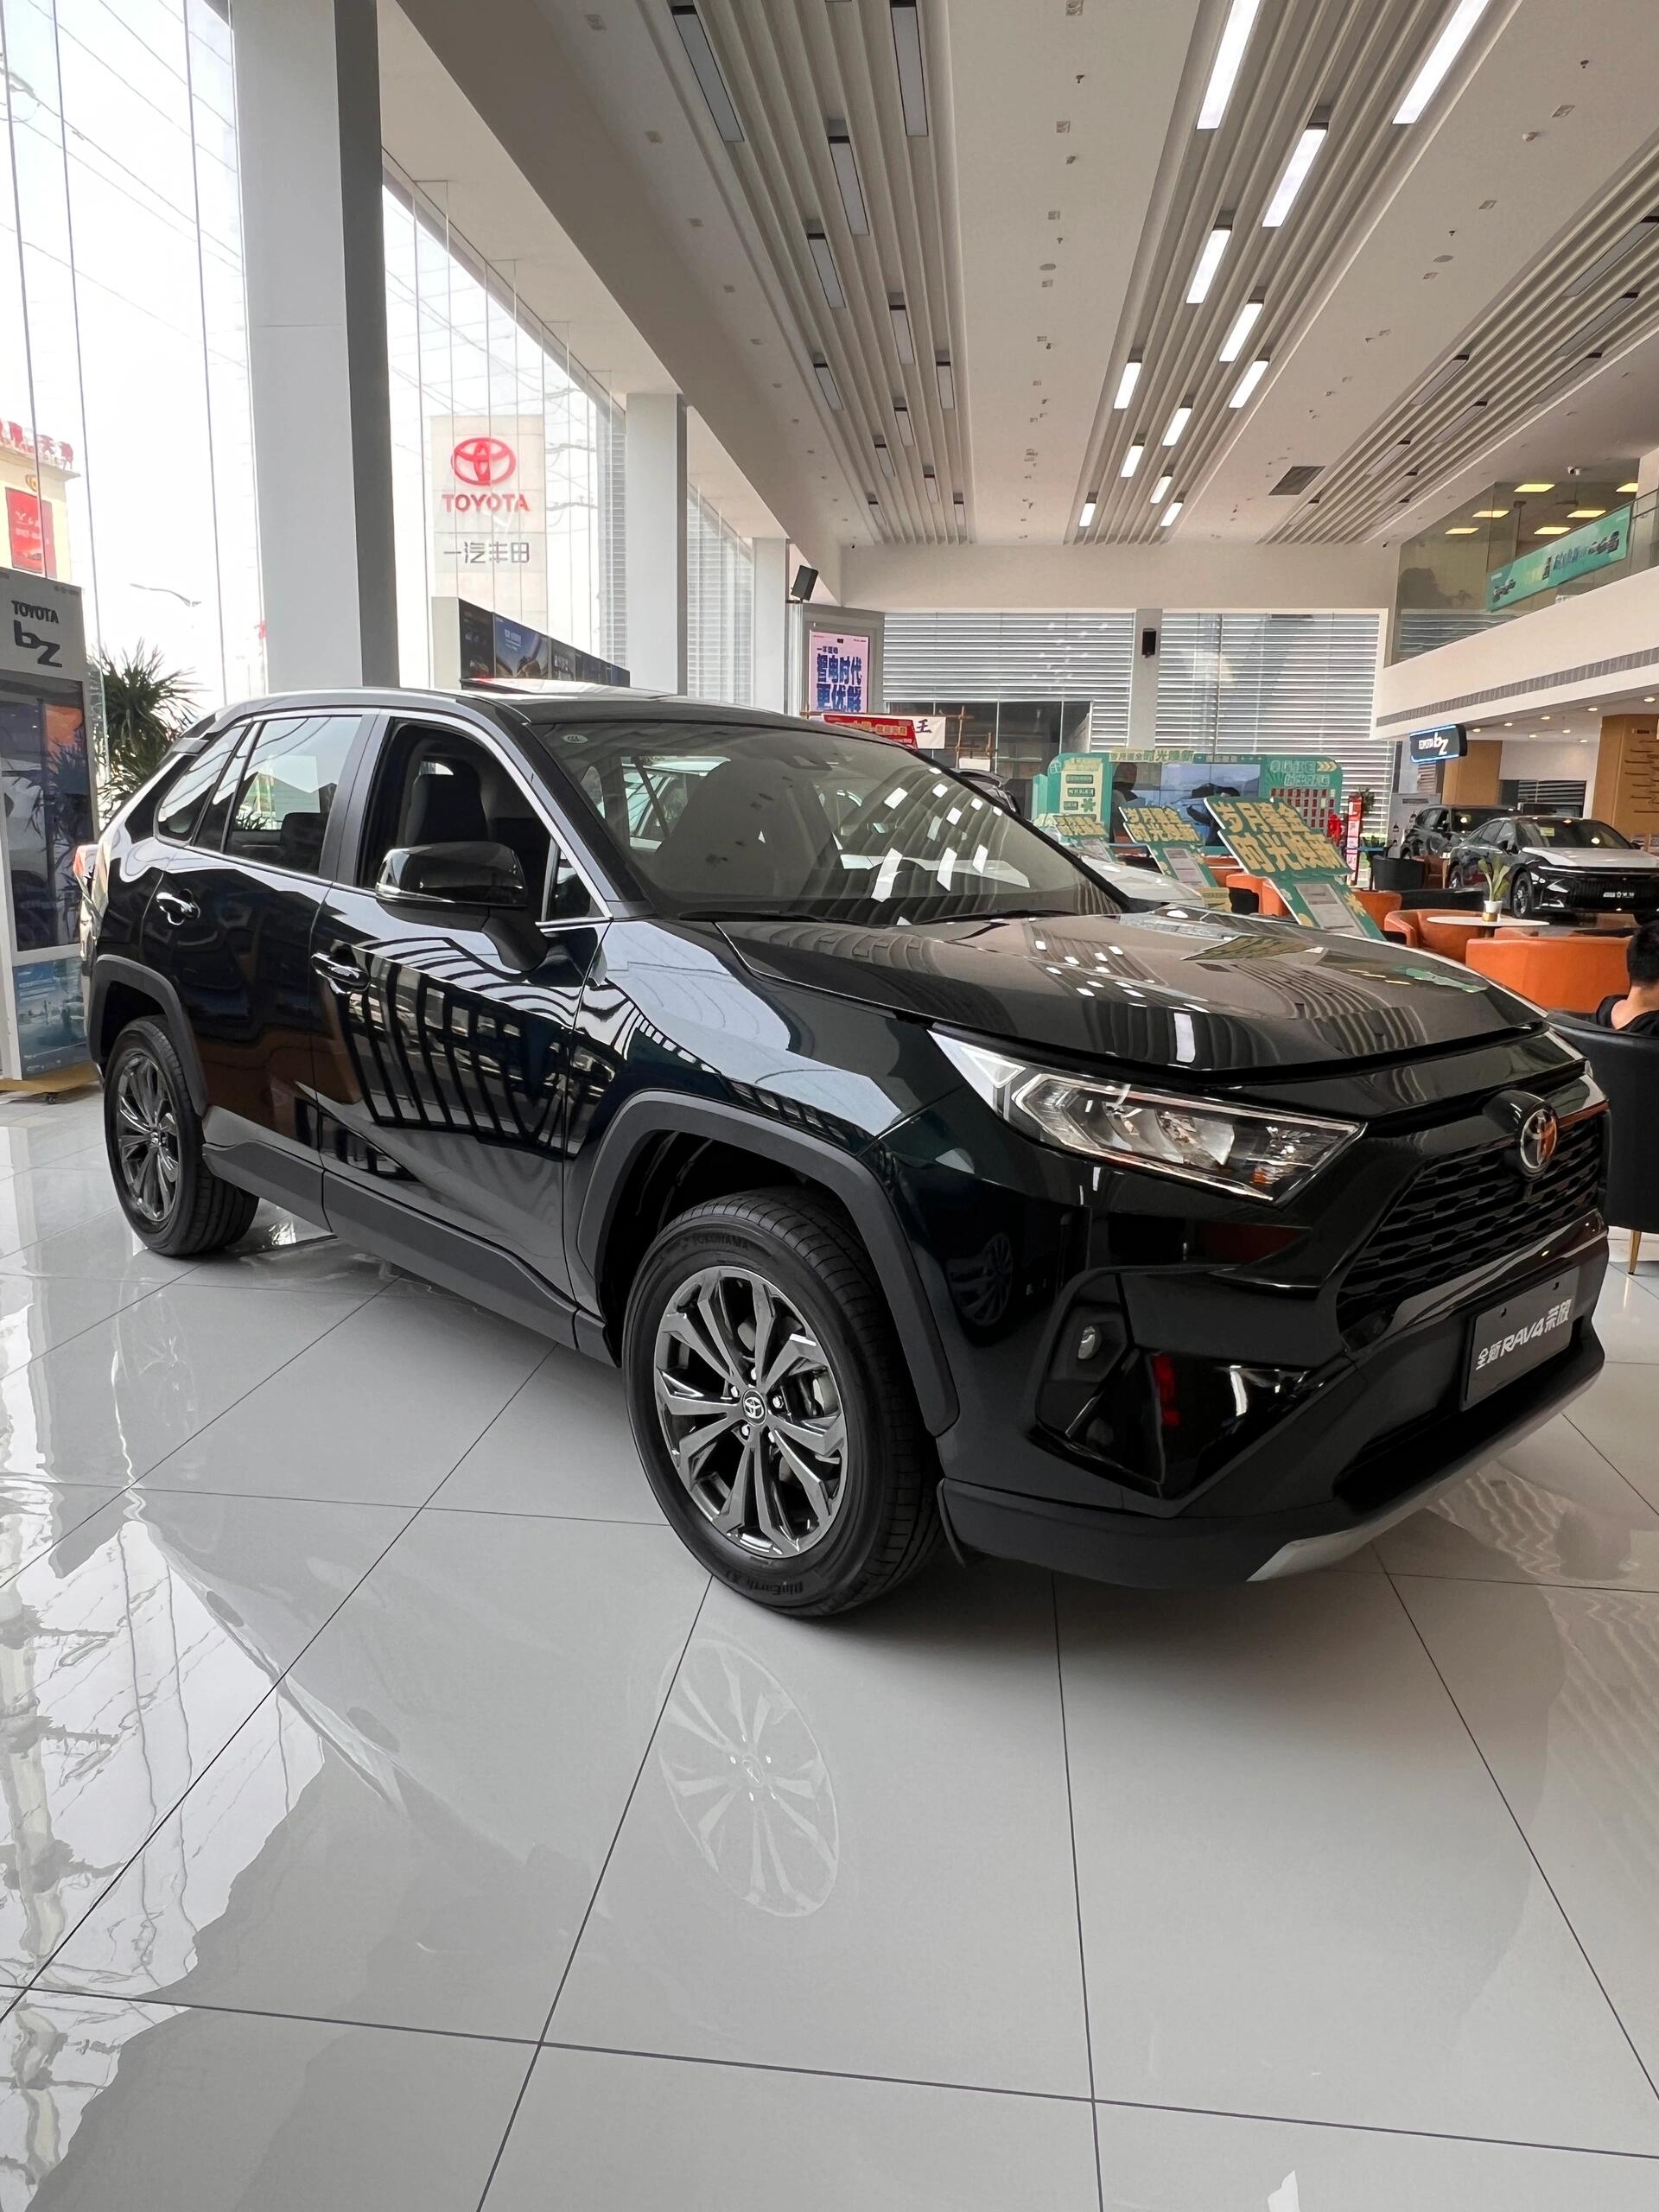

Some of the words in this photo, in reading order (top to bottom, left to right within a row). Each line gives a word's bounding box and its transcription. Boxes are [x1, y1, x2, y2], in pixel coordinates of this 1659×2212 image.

[442, 493, 531, 512] TOYOTA
[443, 541, 530, 563] 一汽丰田
[11, 601, 59, 624] TOYOTA
[817, 653, 862, 685] 智电时代
